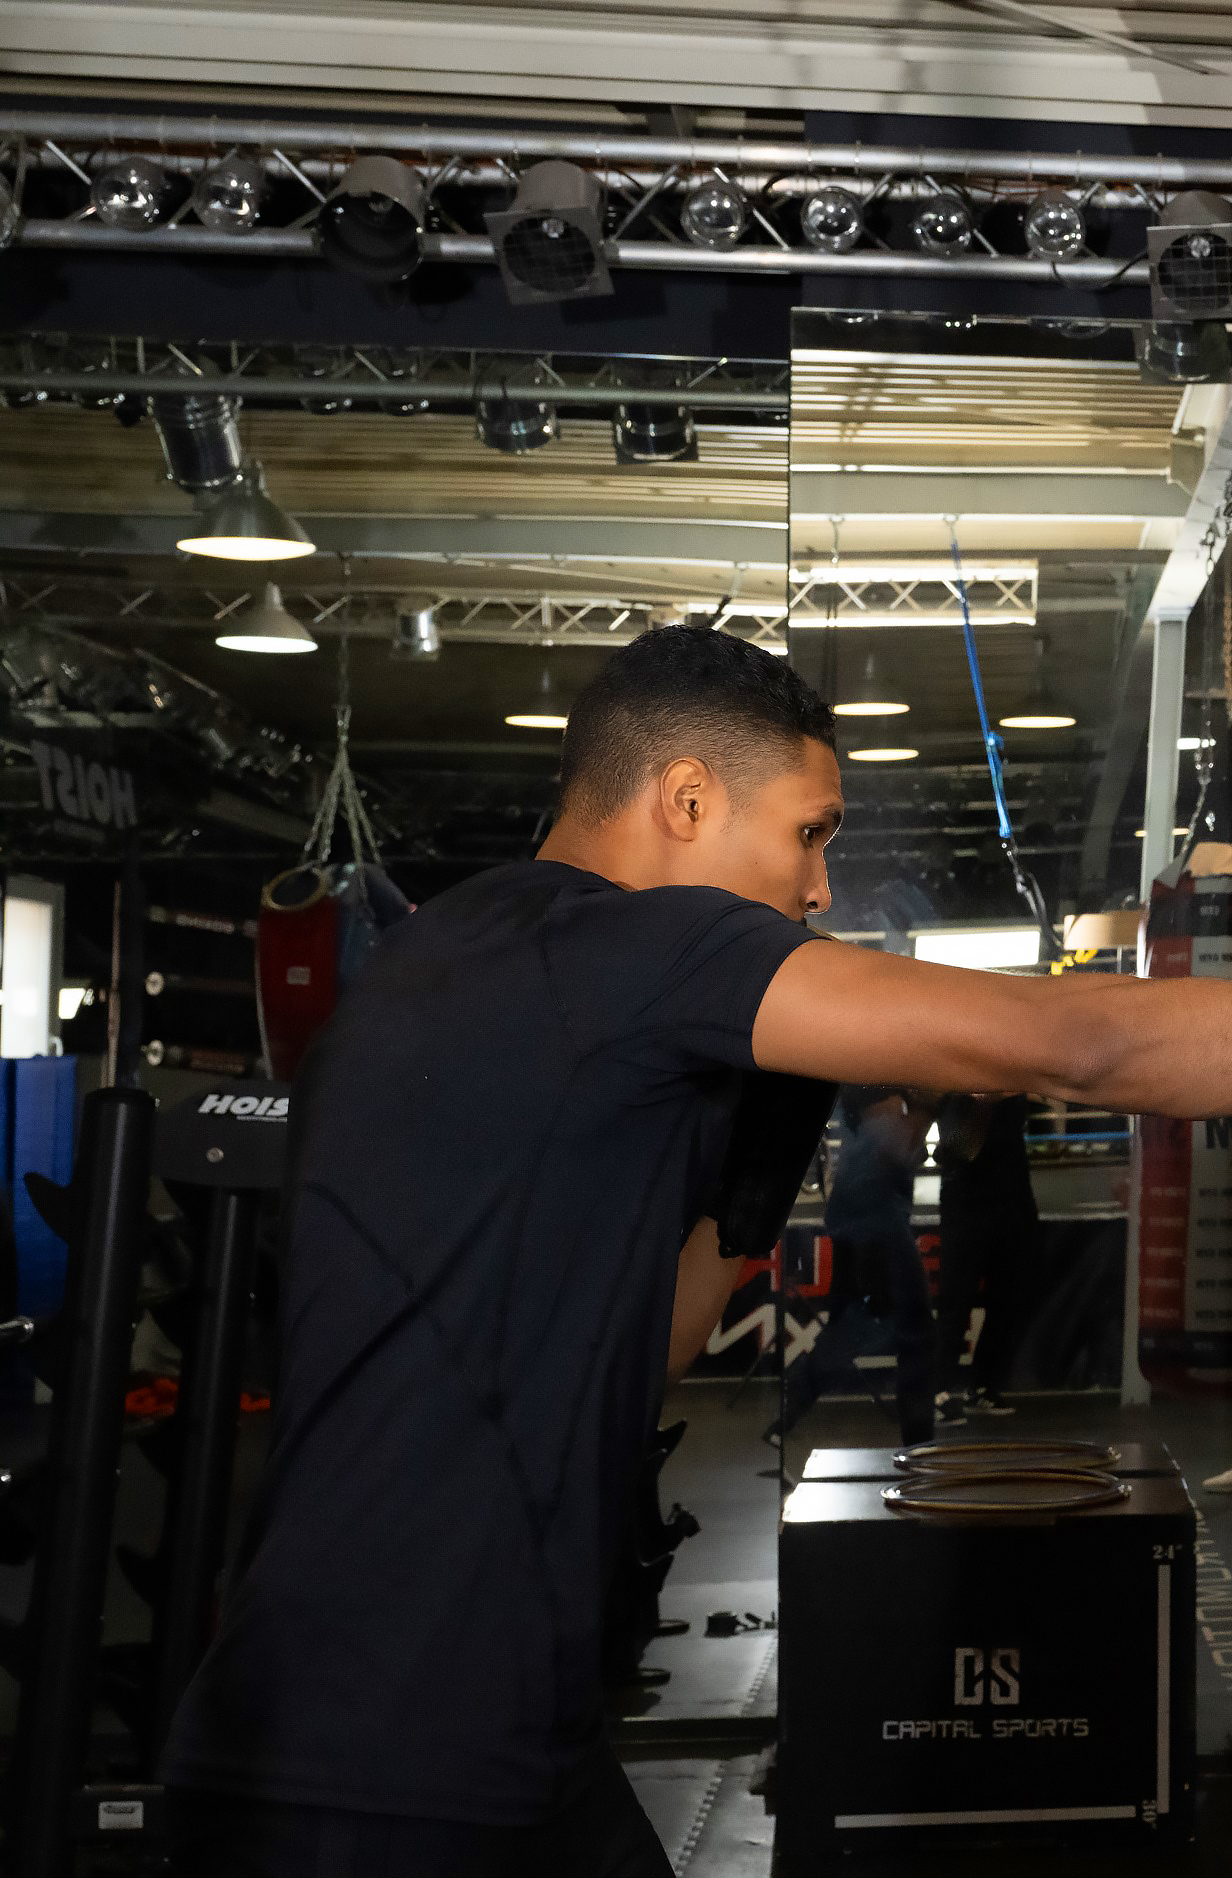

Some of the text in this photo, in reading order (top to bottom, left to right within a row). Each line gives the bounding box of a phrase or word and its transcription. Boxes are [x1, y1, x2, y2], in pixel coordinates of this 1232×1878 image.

[198, 1094, 290, 1116] HOIS
[882, 1718, 1089, 1740] CAPITAL SPORTS
